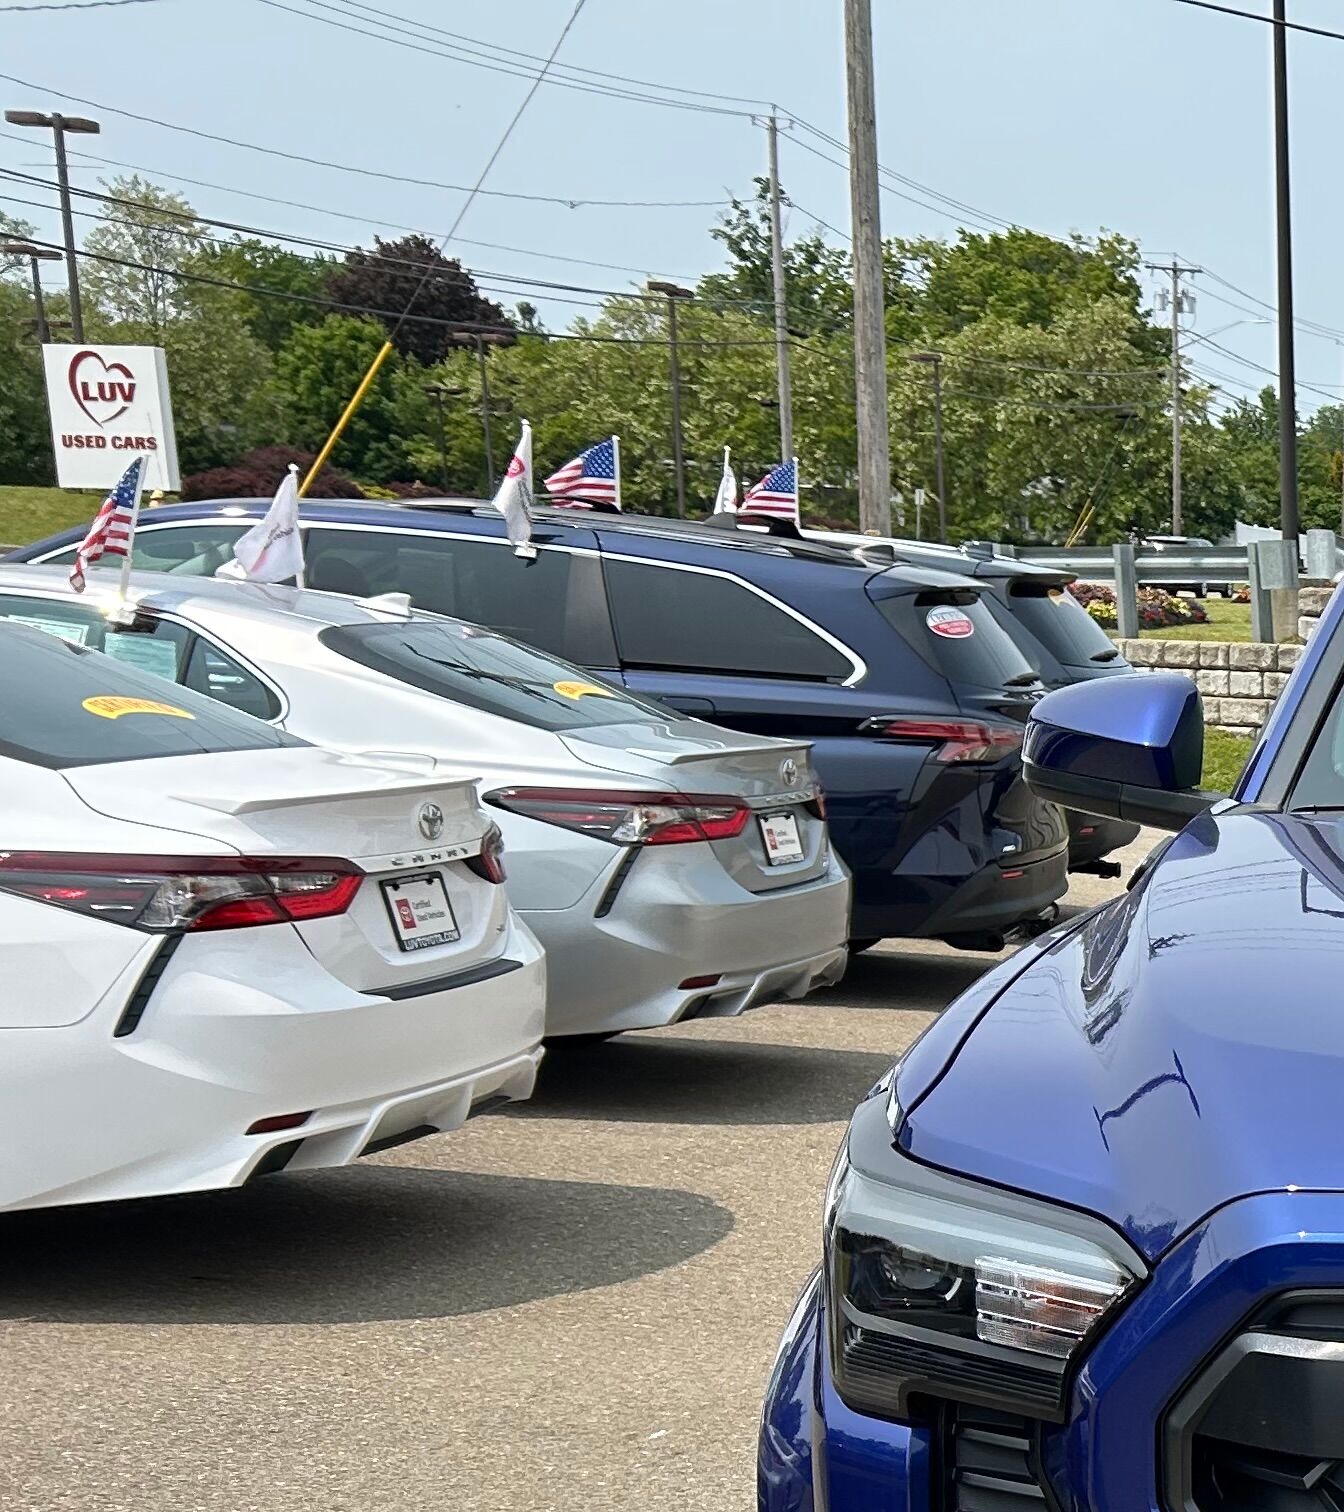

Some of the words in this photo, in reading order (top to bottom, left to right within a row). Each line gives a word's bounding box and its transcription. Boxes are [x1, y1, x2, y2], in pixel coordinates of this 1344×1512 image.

[80, 381, 136, 403] LUV
[61, 434, 106, 449] USED
[110, 435, 157, 450] CARS
